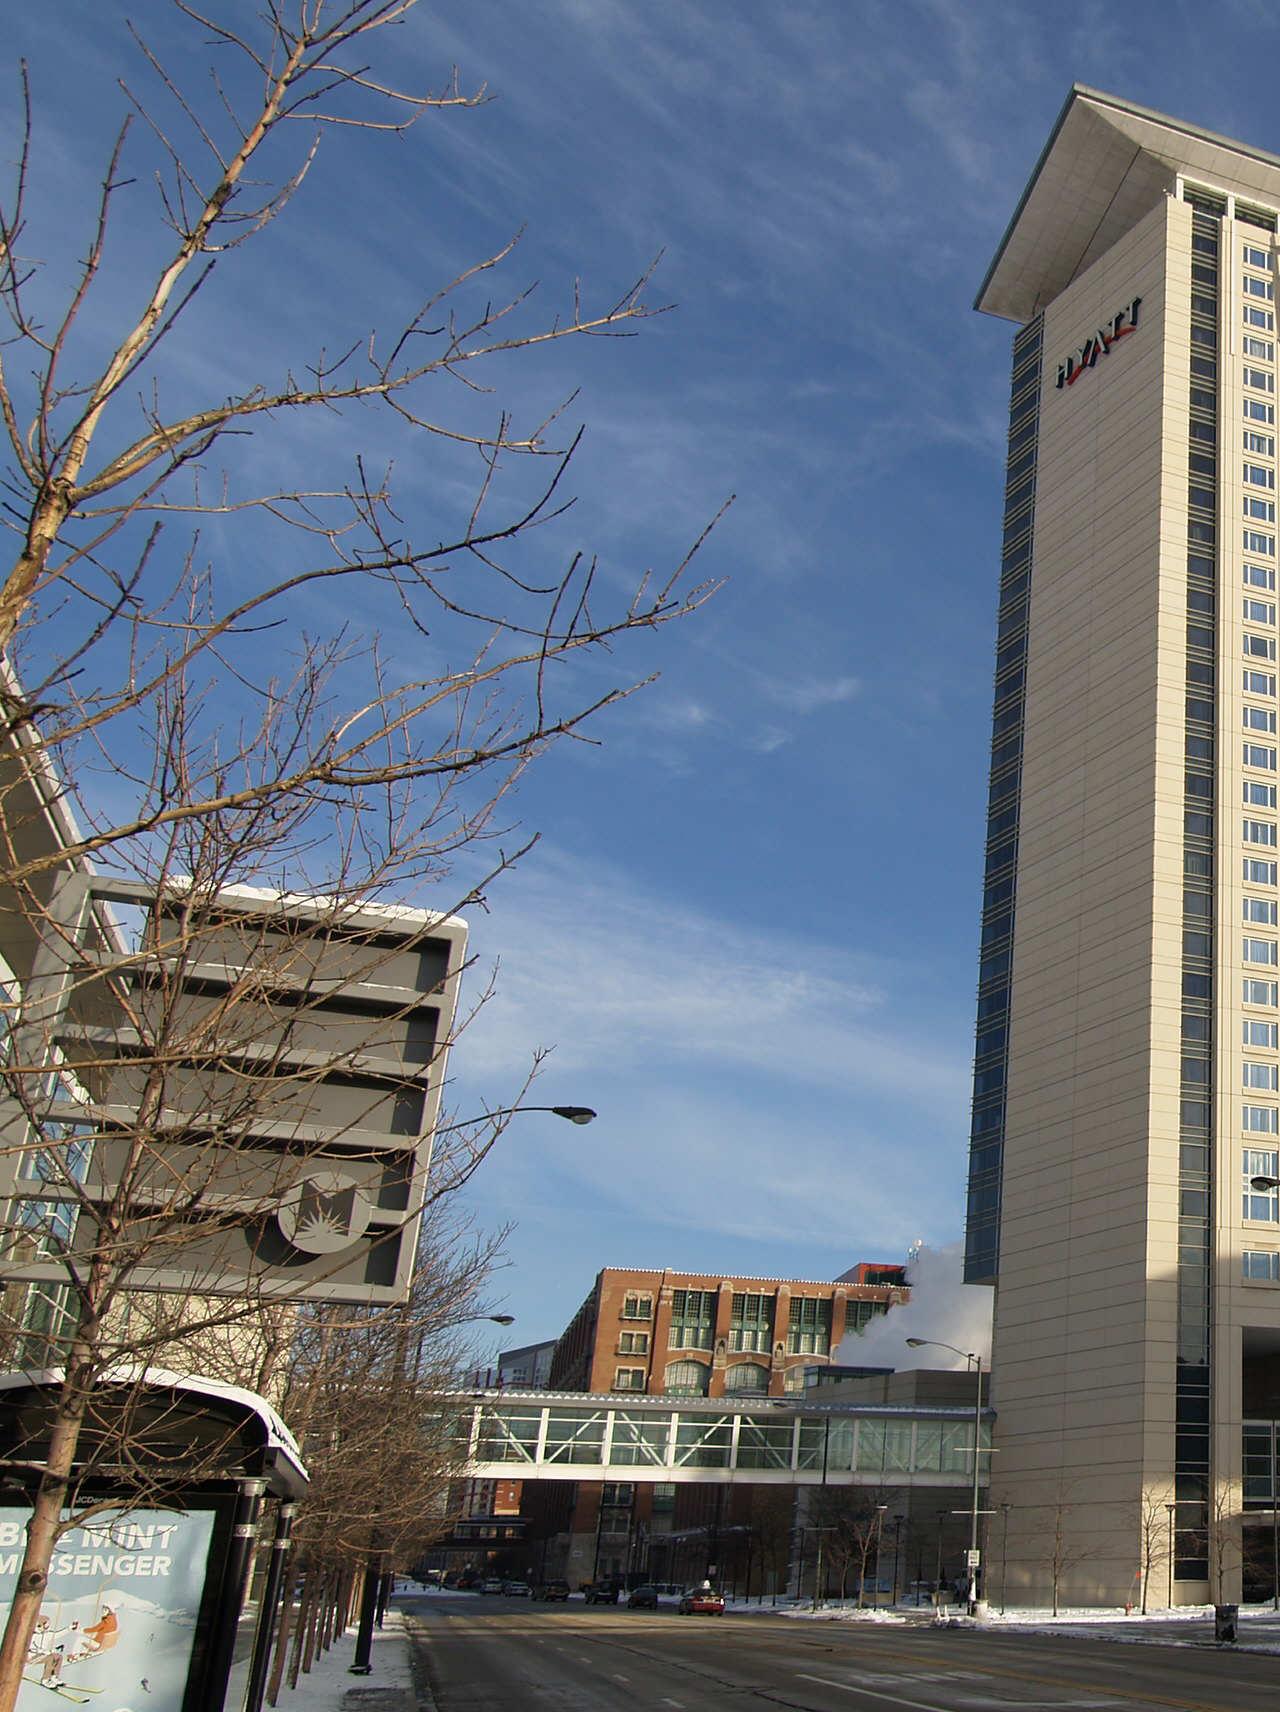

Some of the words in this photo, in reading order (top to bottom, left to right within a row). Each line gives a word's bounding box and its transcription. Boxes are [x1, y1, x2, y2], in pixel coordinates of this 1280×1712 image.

[1056, 297, 1142, 389] HYATT
[81, 1524, 178, 1549] MINT
[0, 1553, 172, 1576] MSENGER
